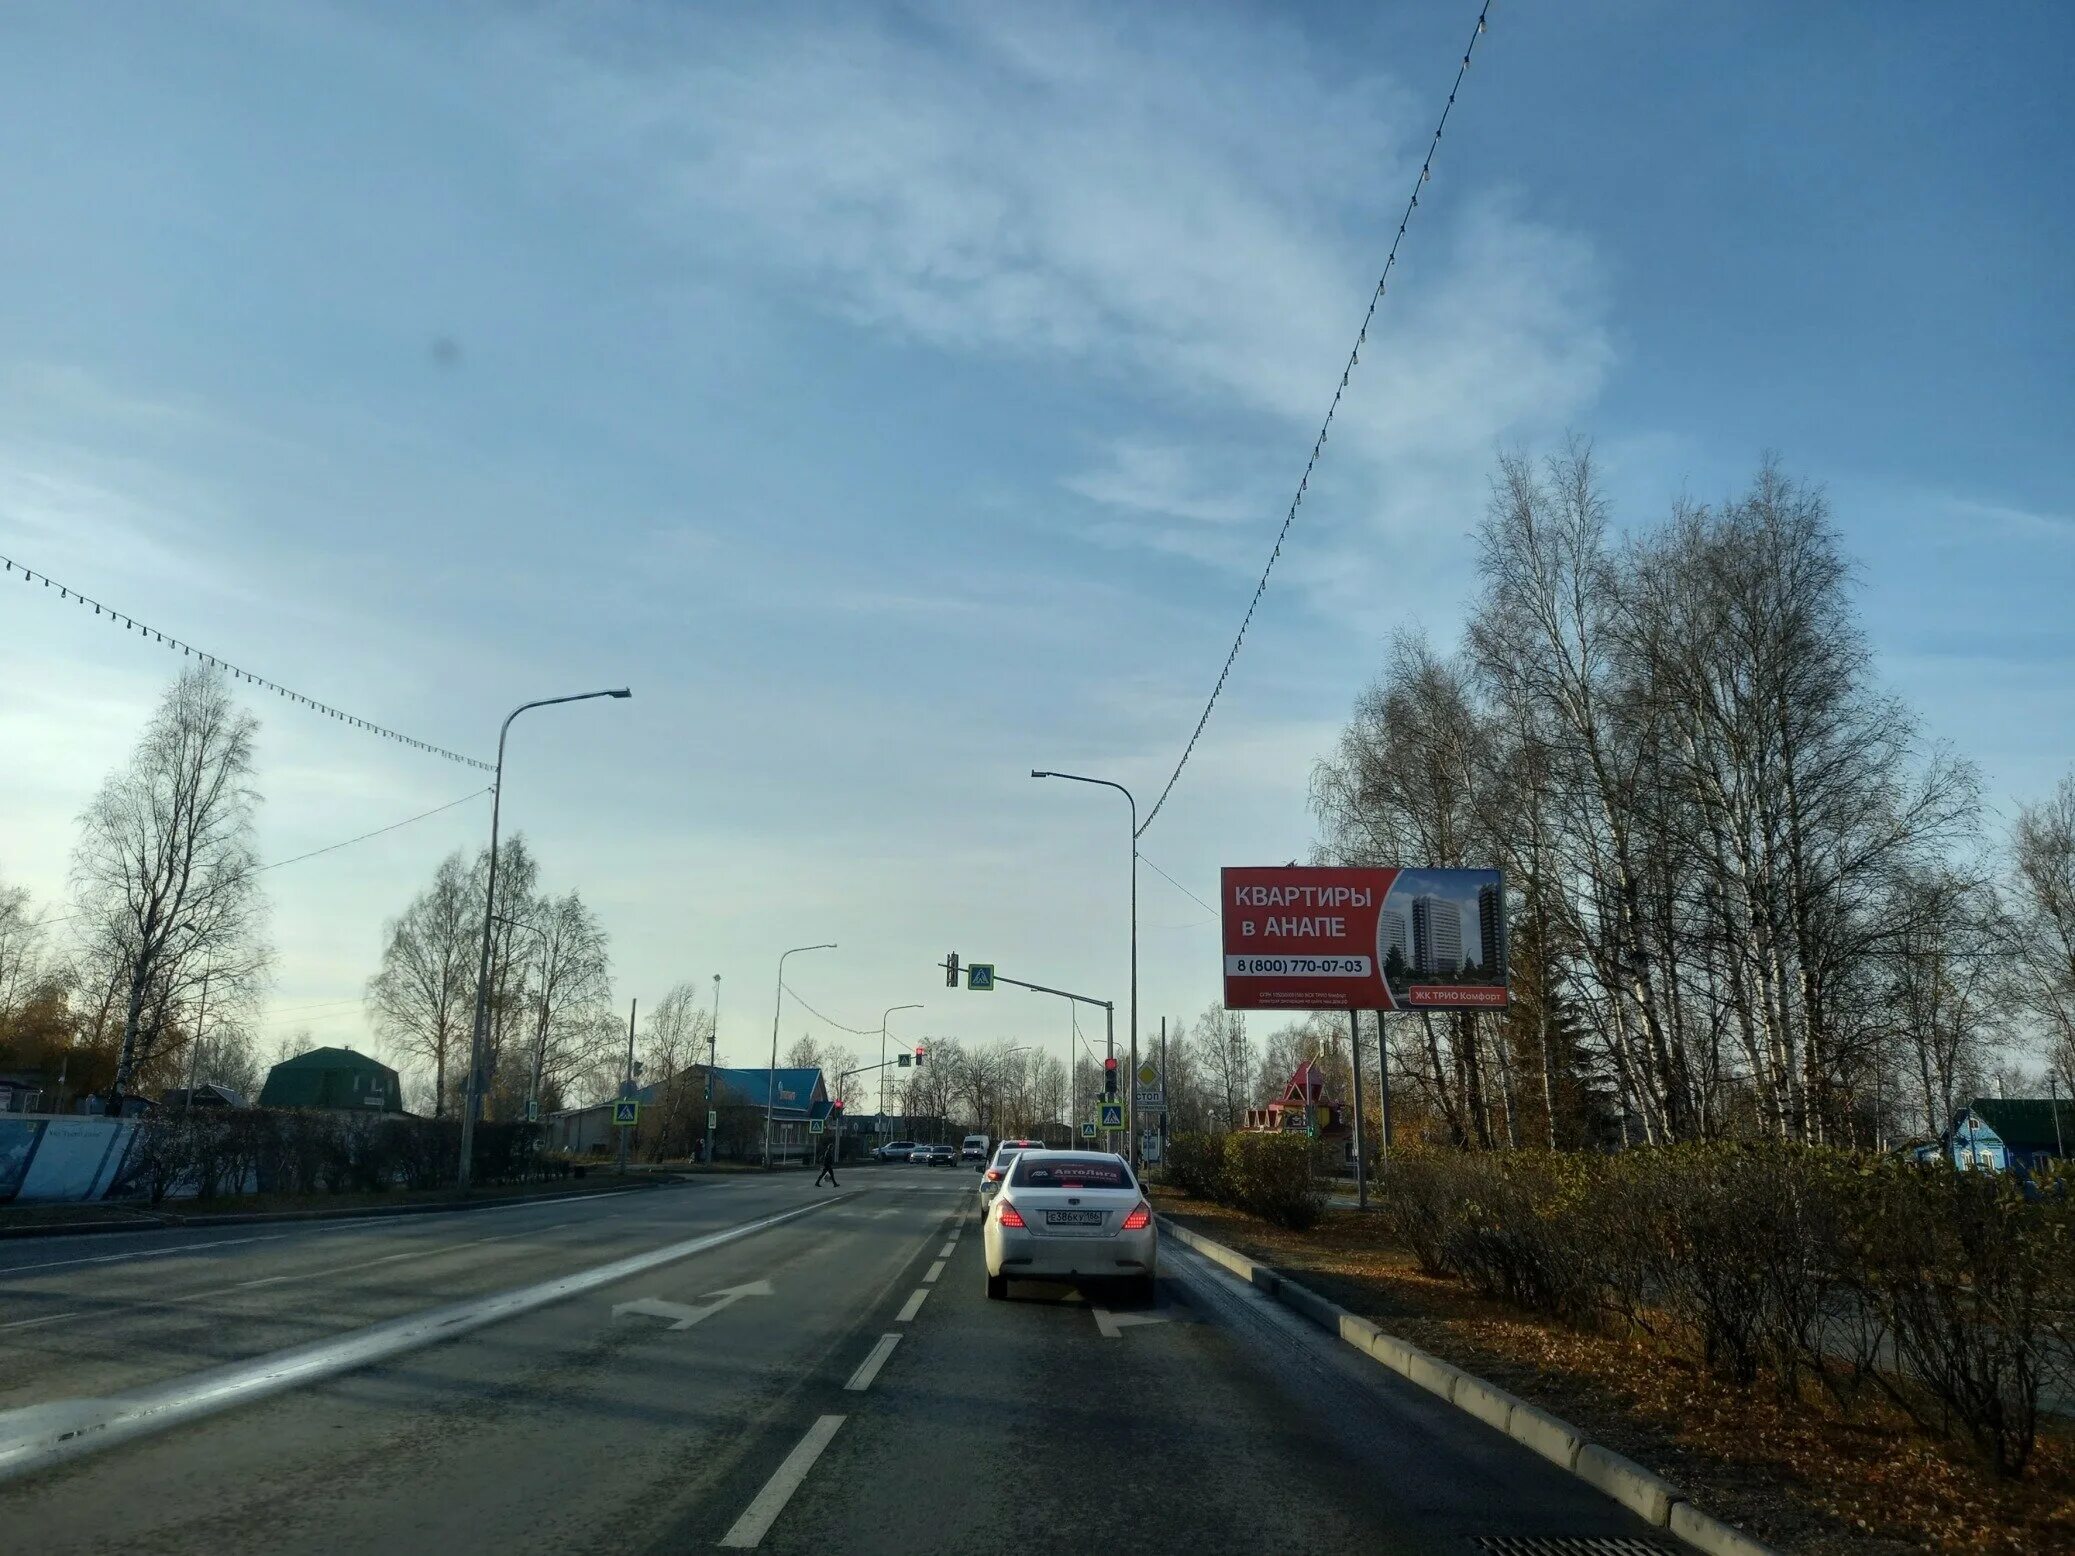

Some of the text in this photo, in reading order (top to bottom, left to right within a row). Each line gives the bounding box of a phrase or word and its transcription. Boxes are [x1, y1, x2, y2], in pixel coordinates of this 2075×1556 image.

[1236, 886, 1371, 907] КВАРТИРЫ
[1242, 917, 1346, 937] в АНАПЕ
[1237, 960, 1363, 974] 8 (800) 770-07-03
[1415, 991, 1501, 1002] ЖК ТРИО Комфорт
[1136, 1093, 1159, 1101] СТОП
